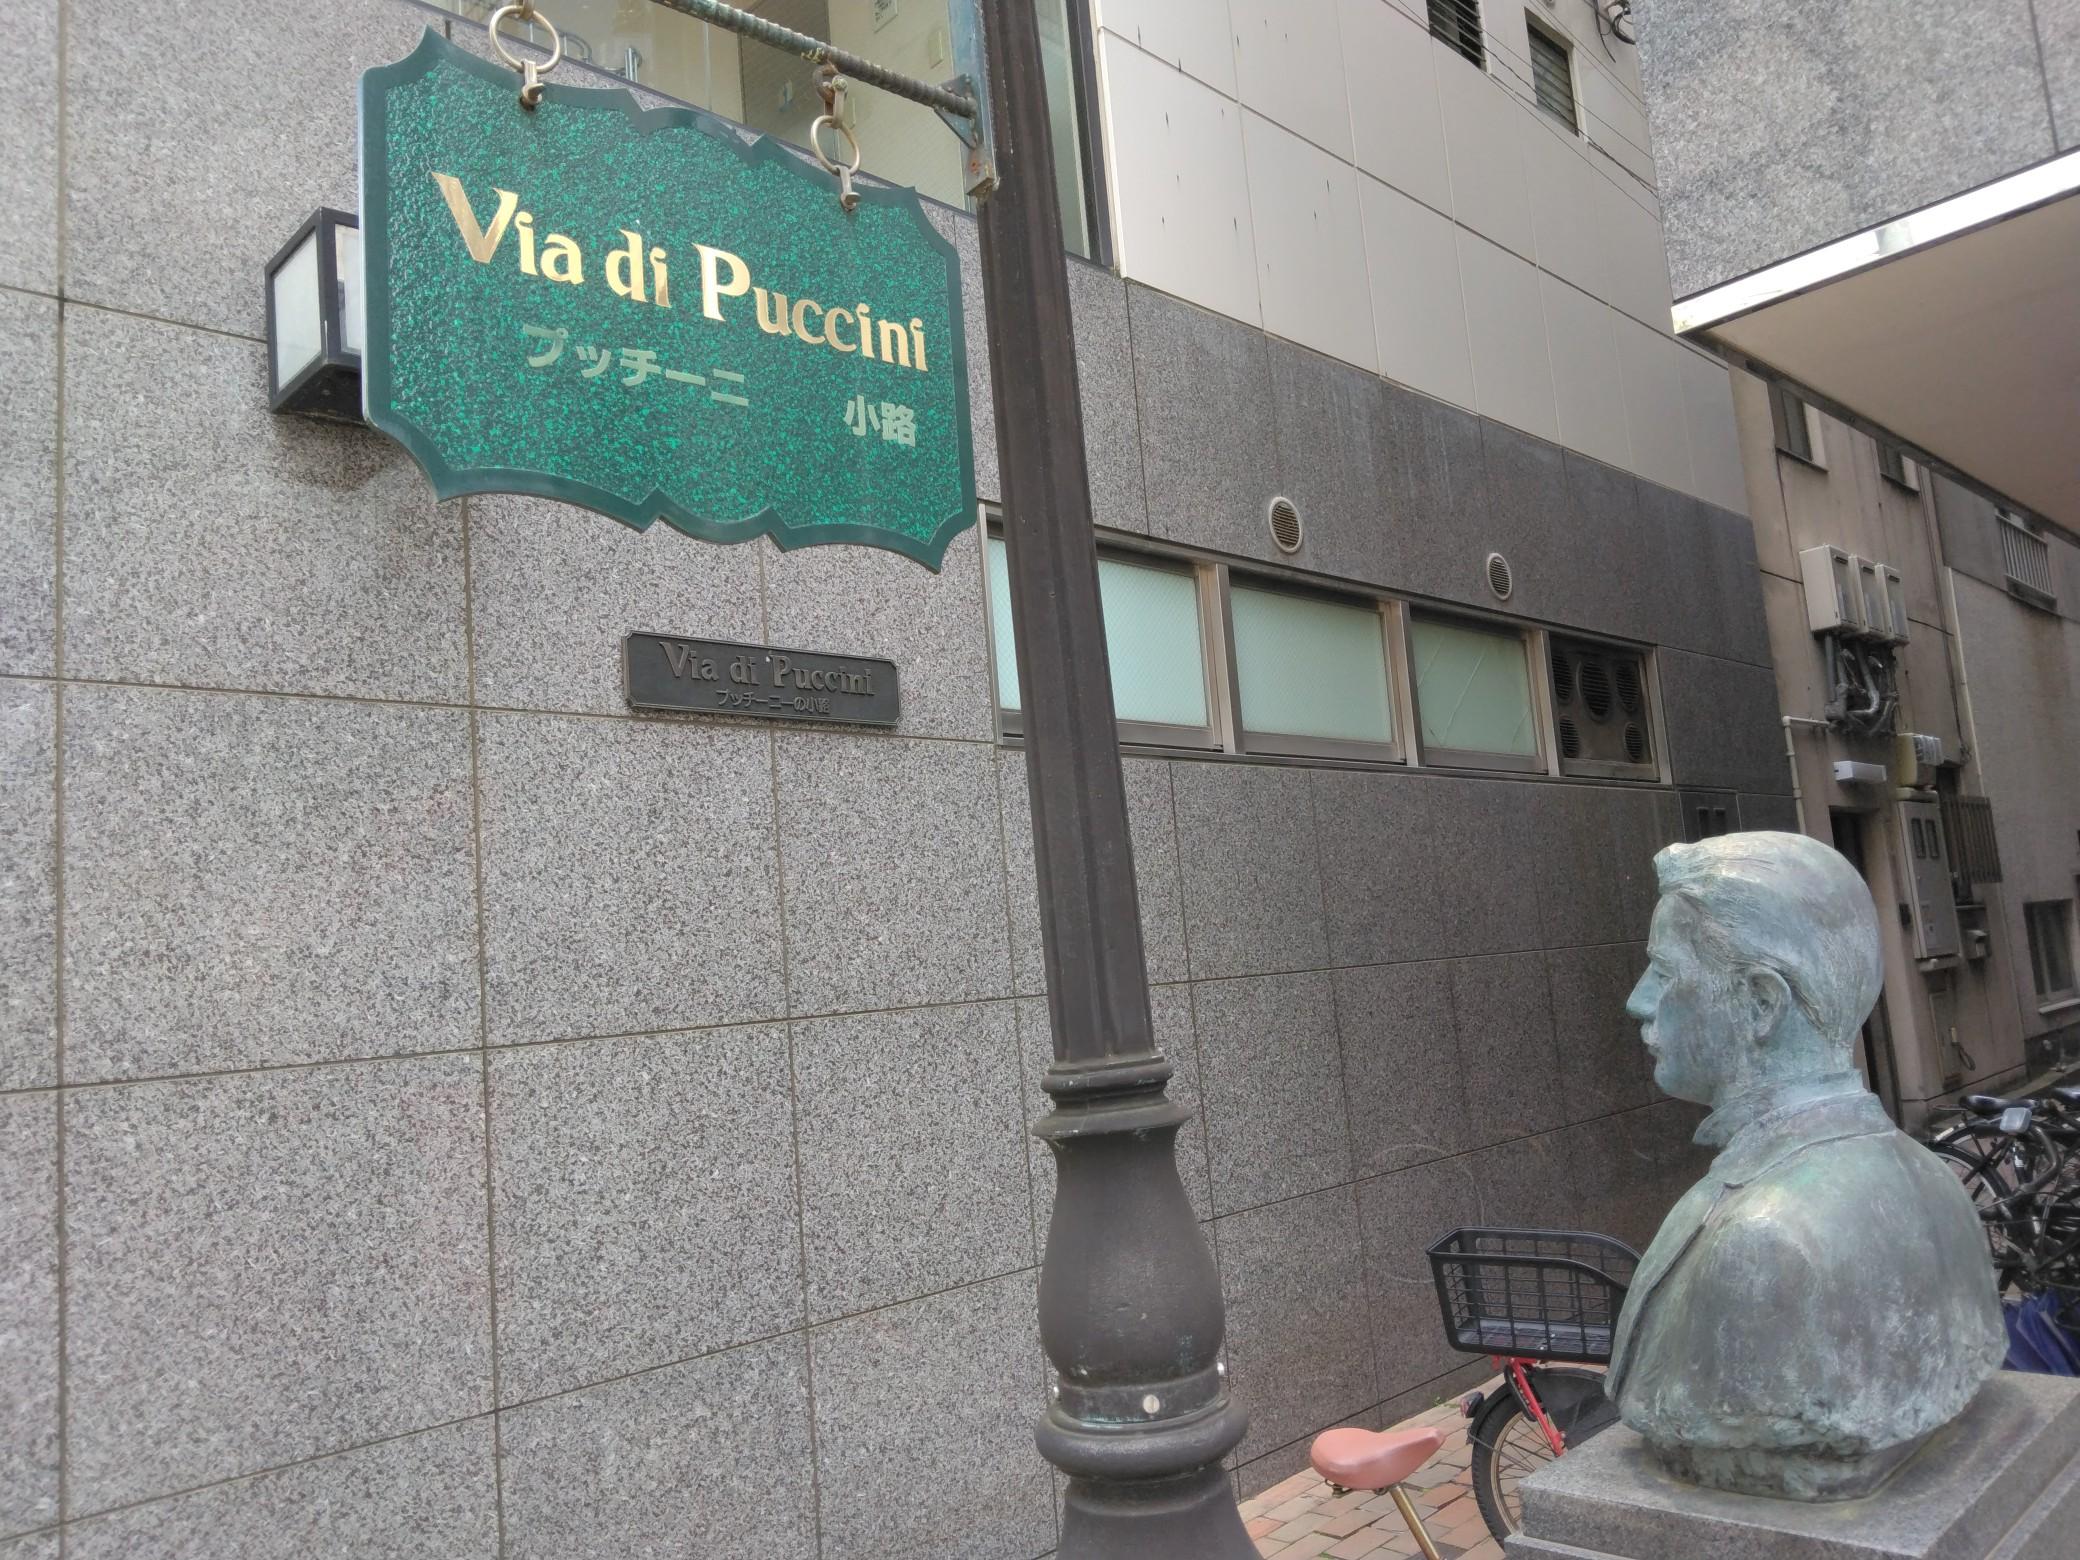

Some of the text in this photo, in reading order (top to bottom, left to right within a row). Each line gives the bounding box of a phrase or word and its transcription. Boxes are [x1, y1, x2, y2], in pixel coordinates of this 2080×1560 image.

[431, 172, 928, 372] Via di Puccini
[522, 323, 916, 447] プッチーニ 小路
[659, 641, 875, 696] Via di Puccini
